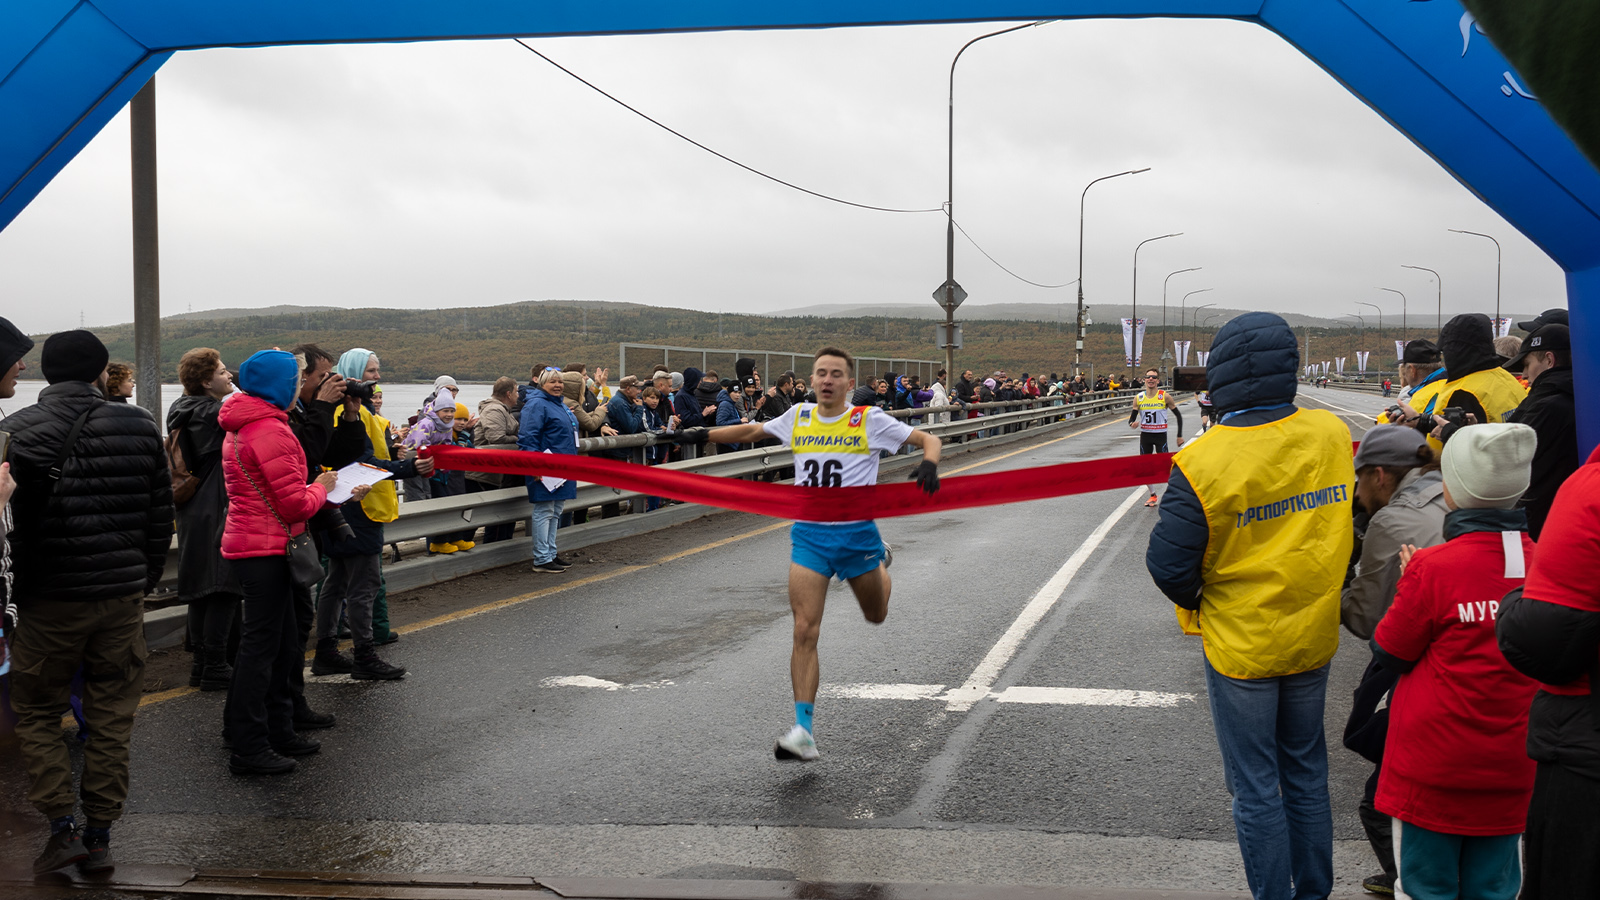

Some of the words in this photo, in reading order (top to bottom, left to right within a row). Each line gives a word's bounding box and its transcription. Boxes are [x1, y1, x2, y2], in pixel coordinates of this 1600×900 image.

[1145, 411, 1157, 424] 51
[794, 435, 862, 447] МУРМАНСК
[803, 459, 843, 488] 36
[1236, 484, 1348, 528] ГОРСПОРТКОМИТЕТ
